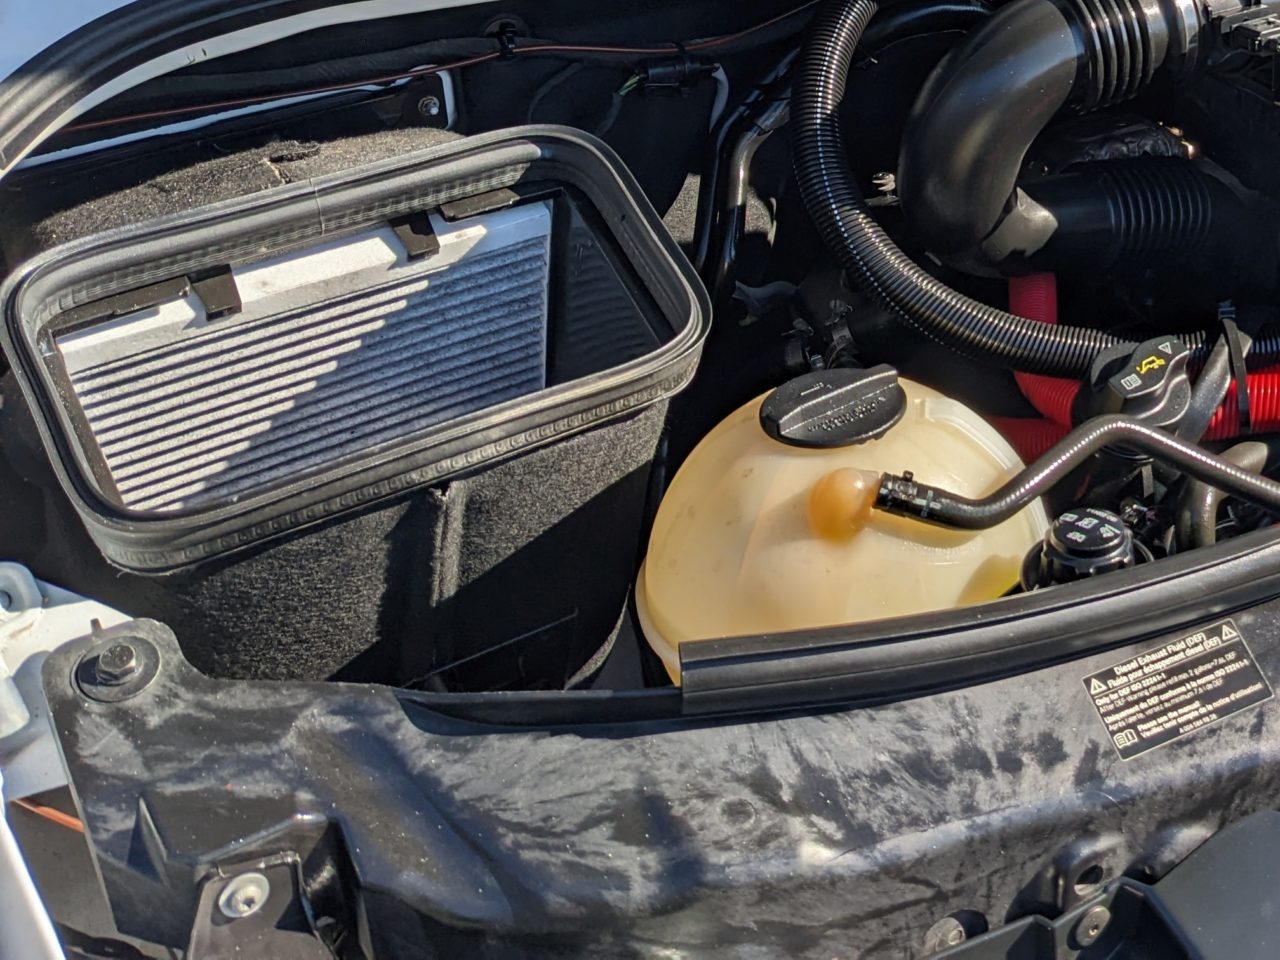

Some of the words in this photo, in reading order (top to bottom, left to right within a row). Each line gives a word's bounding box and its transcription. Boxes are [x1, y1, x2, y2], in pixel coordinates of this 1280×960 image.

[1107, 676, 1128, 688] Fluide
[1128, 669, 1143, 681] pour
[1143, 652, 1185, 673] échappement
[1185, 644, 1204, 656] diesel
[1203, 637, 1221, 649] (DEF)
[1114, 660, 1138, 675] Diesel
[1138, 649, 1168, 665] Exhaust
[1167, 641, 1186, 653] Fluid
[1186, 633, 1206, 646] (DEF)
[1096, 697, 1110, 705] Only
[1118, 687, 1130, 696] DEF
[1131, 683, 1142, 691] ISO
[1142, 673, 1165, 687] 22241-1
[1104, 705, 1139, 723] Uniquement
[1147, 696, 1159, 705] DEF
[1160, 686, 1186, 700] conforme
[1197, 674, 1215, 685] norme
[1214, 669, 1225, 677] ISO
[1225, 660, 1249, 673] 22241-1
[1137, 720, 1157, 731] Please
[1141, 726, 1164, 737] Veuillez
[1163, 719, 1177, 728] tenir
[1177, 711, 1199, 723] compte
[1213, 697, 1230, 707] notice
